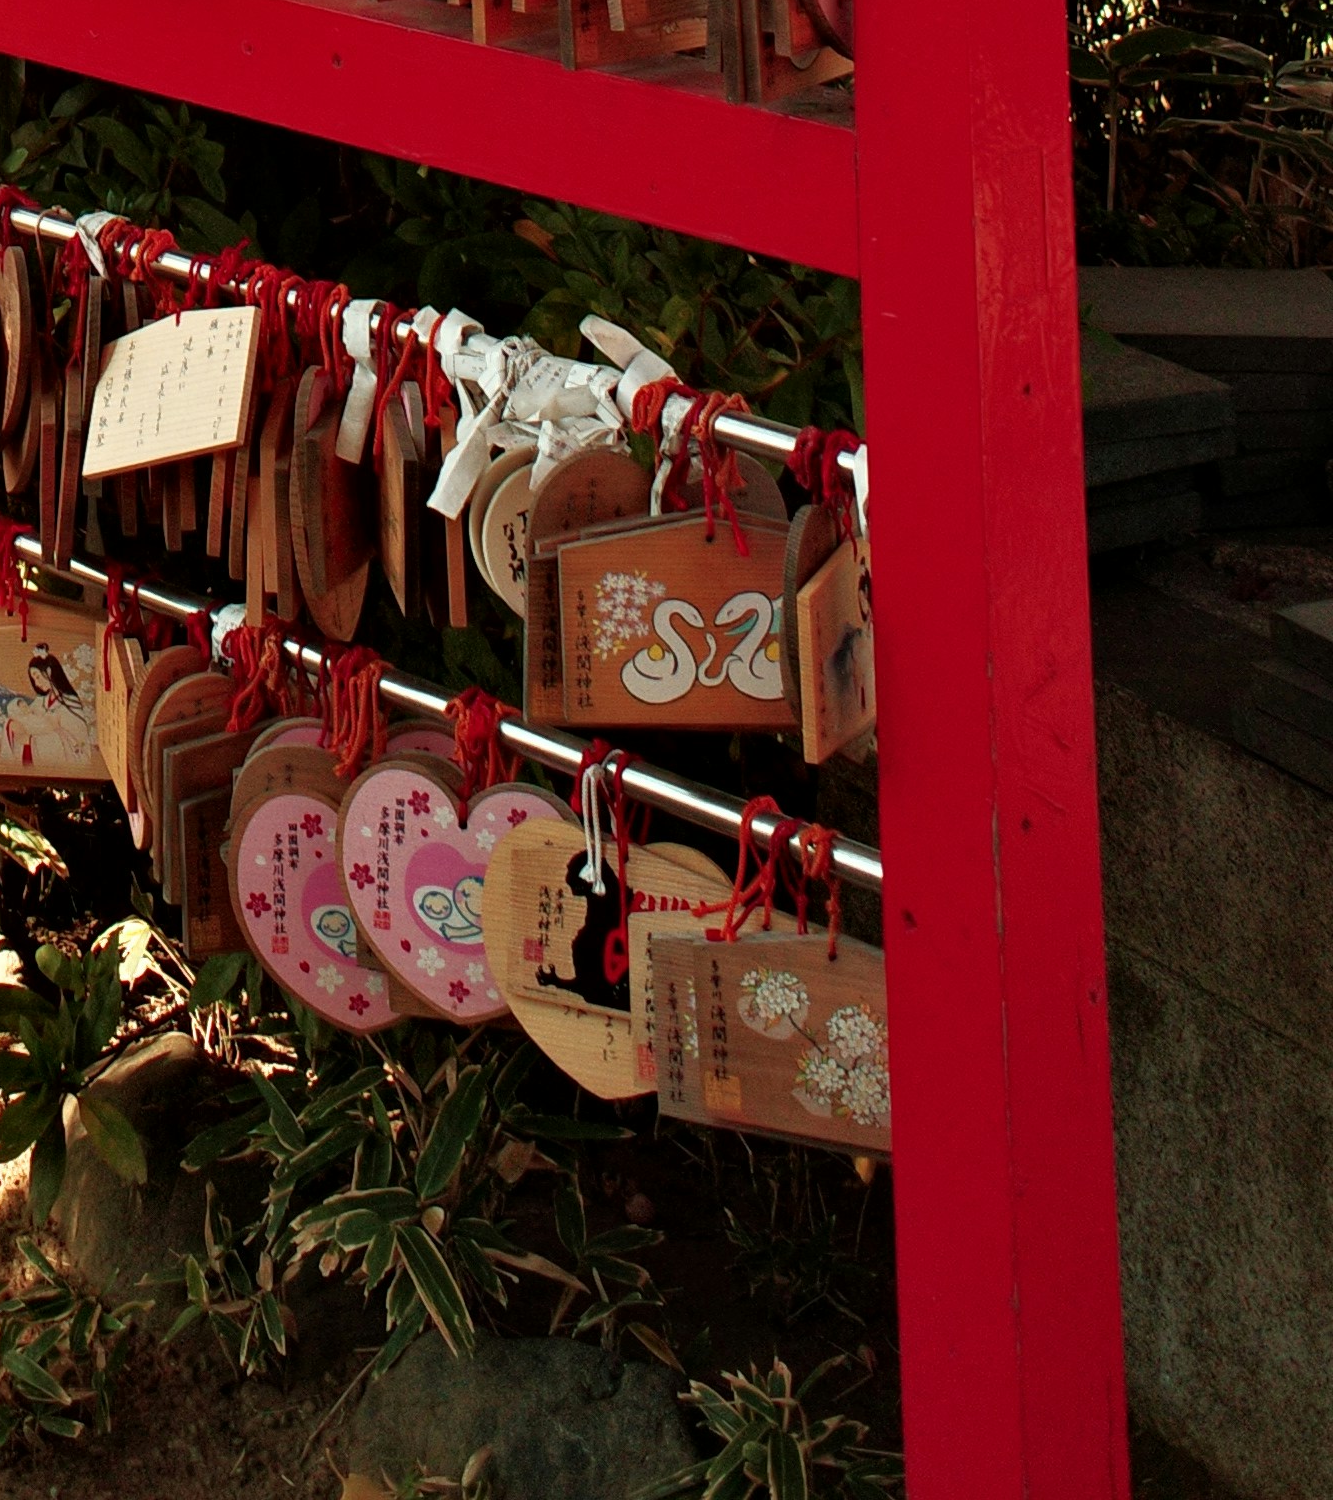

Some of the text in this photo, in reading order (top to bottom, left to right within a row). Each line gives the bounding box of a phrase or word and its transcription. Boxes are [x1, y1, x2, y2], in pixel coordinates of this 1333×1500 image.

[576, 590, 594, 710] 多摩川浅間神社
[288, 823, 300, 872] 田園調布
[376, 805, 391, 911] 多摩川浅間神社
[394, 797, 406, 847] 田園調布
[271, 832, 288, 935] 多摩川浅間神社
[537, 884, 551, 948] 浅間神社
[553, 887, 564, 928] 多摩川
[666, 982, 685, 1103] 多摩川浅間神社
[709, 959, 729, 1081] 多摩川浅間神社
